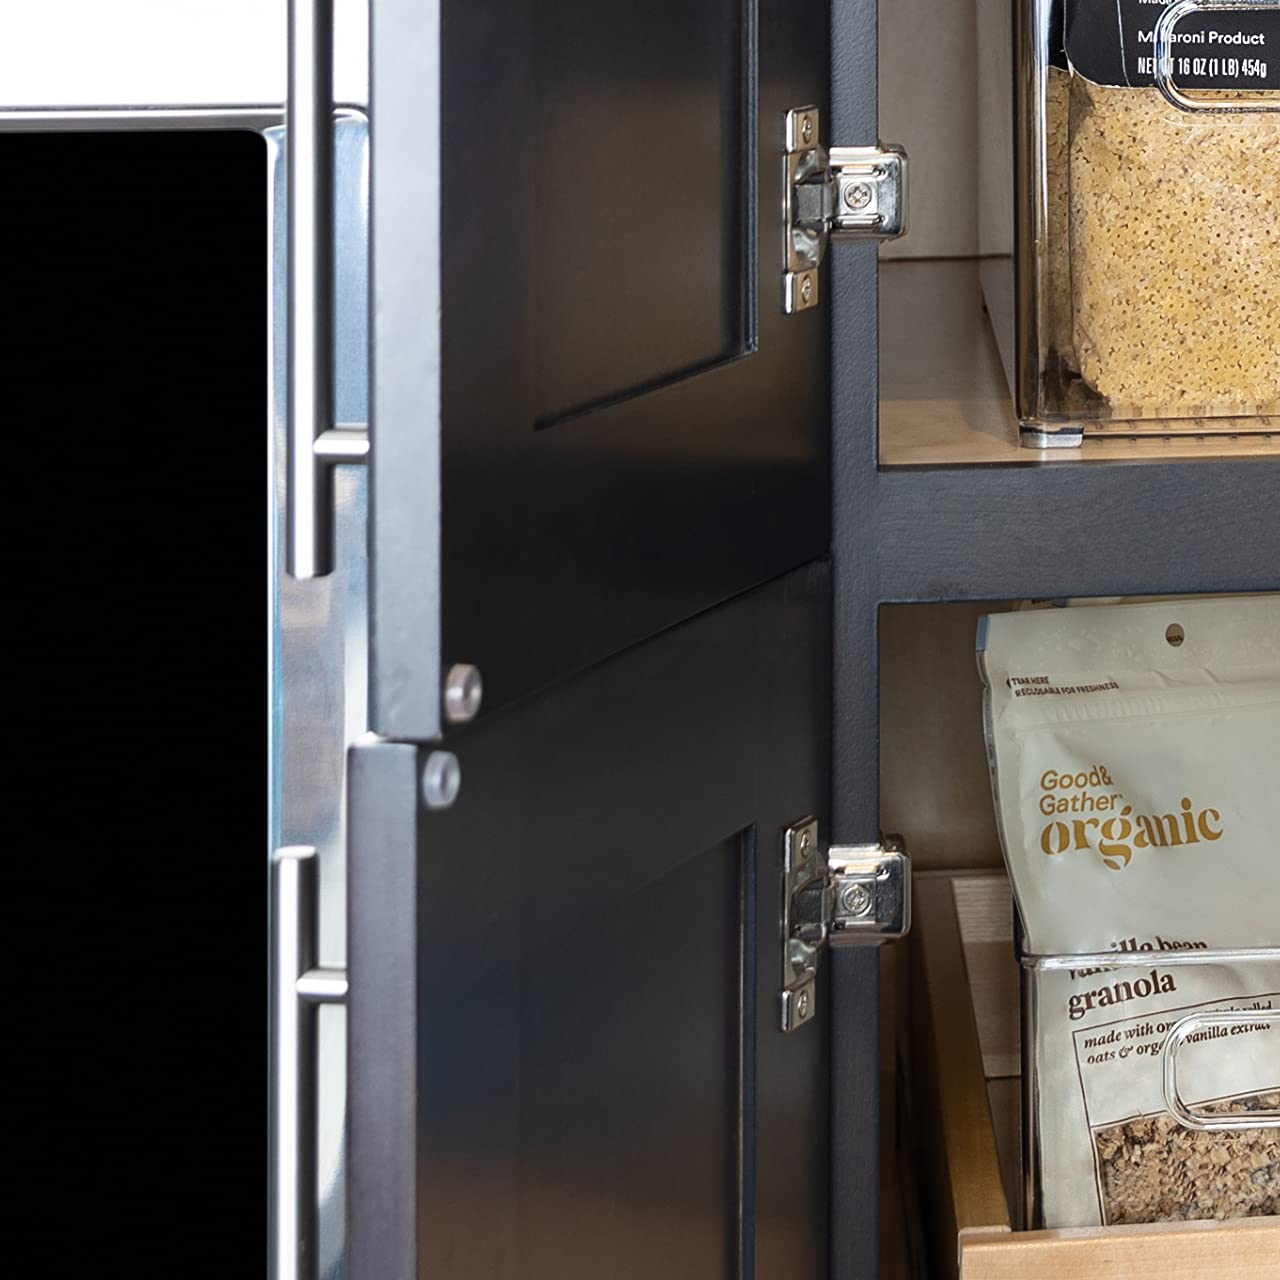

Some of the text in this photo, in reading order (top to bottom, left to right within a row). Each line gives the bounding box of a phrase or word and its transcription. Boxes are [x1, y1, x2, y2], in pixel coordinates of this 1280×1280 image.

[1137, 30, 1266, 46] Maroni Product
[1178, 58, 1191, 74] 16
[1192, 59, 1207, 75] OZ
[1208, 58, 1219, 77] (1
[1221, 58, 1239, 77] LB)
[1241, 60, 1267, 78] 454g
[1040, 765, 1114, 791] Good&
[1039, 792, 1118, 816] Gather
[1040, 797, 1224, 870] organic
[1068, 970, 1177, 1020] granola
[1084, 1028, 1122, 1048] made
[1124, 1021, 1154, 1041] with
[1086, 1050, 1116, 1065] oats
[1186, 1024, 1228, 1045] vanilla
